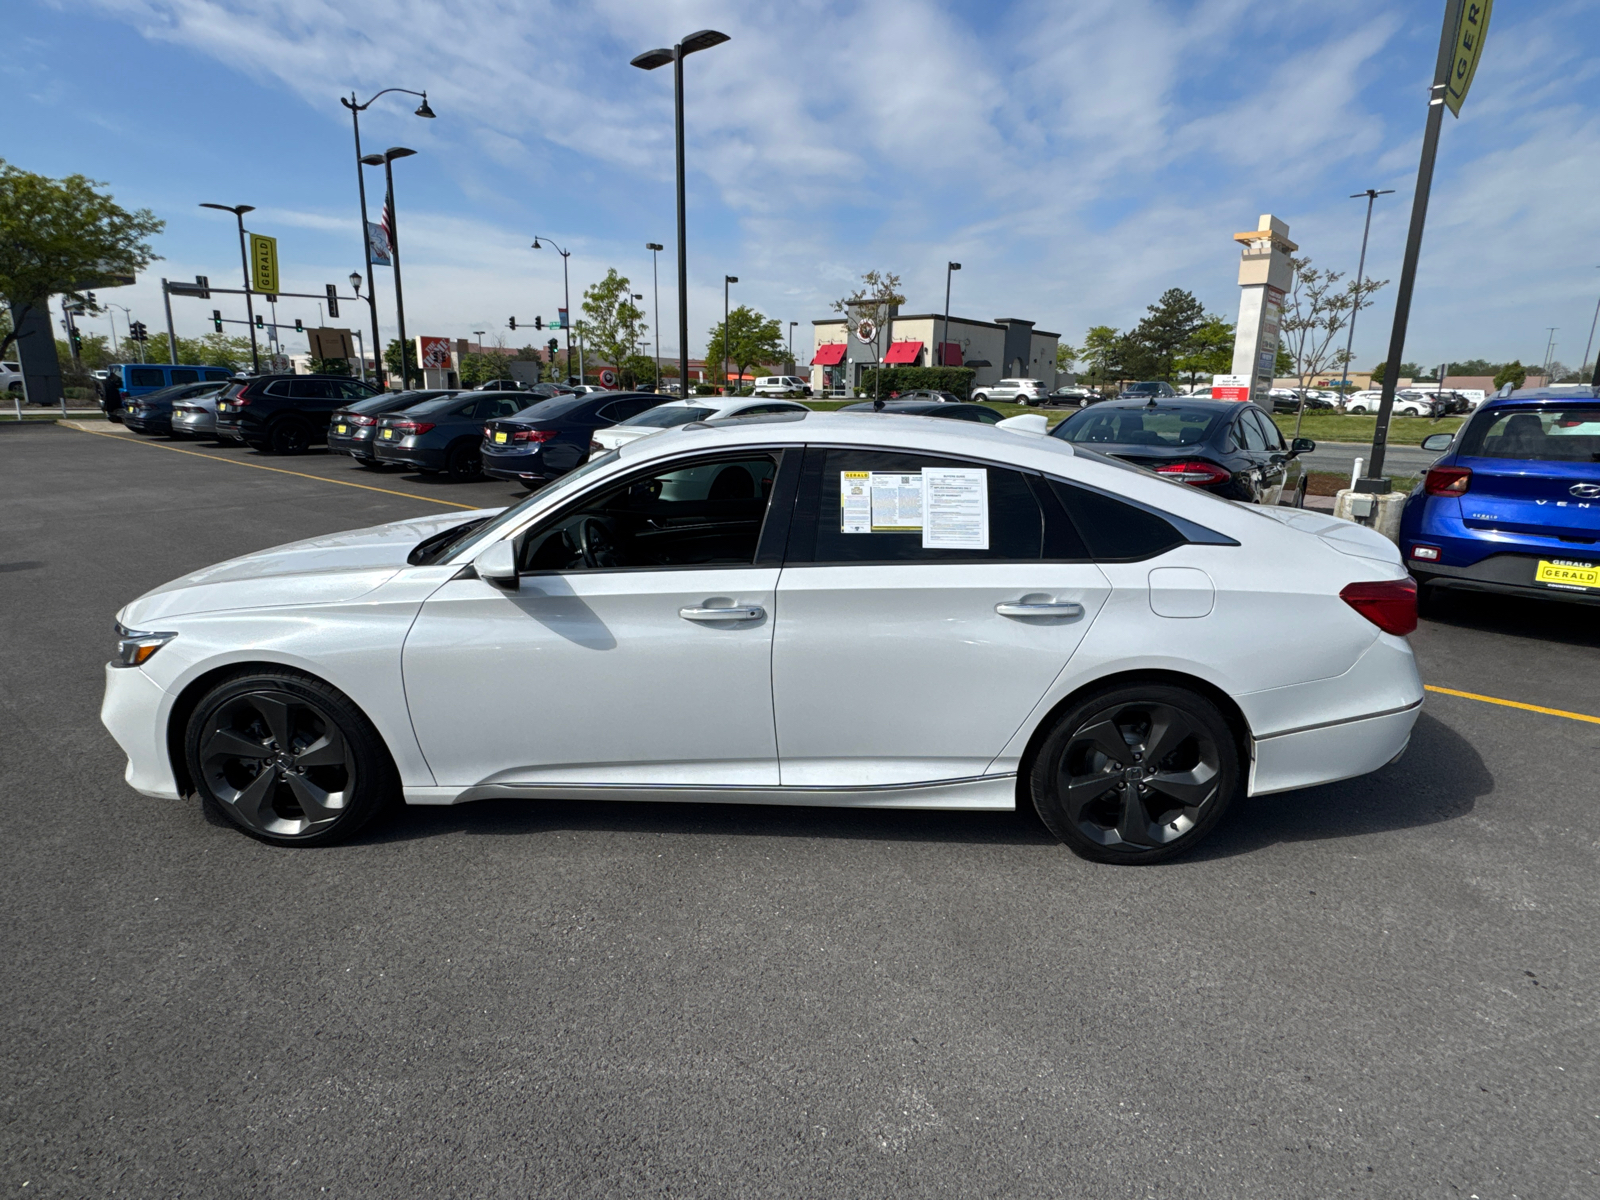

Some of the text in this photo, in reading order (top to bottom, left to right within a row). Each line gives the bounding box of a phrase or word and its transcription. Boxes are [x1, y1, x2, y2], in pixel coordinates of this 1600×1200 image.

[260, 242, 270, 286] GERALD
[425, 341, 436, 353] THE
[1535, 500, 1590, 508] VEN
[1552, 559, 1592, 568] GERALD
[1545, 569, 1594, 581] GERALD
